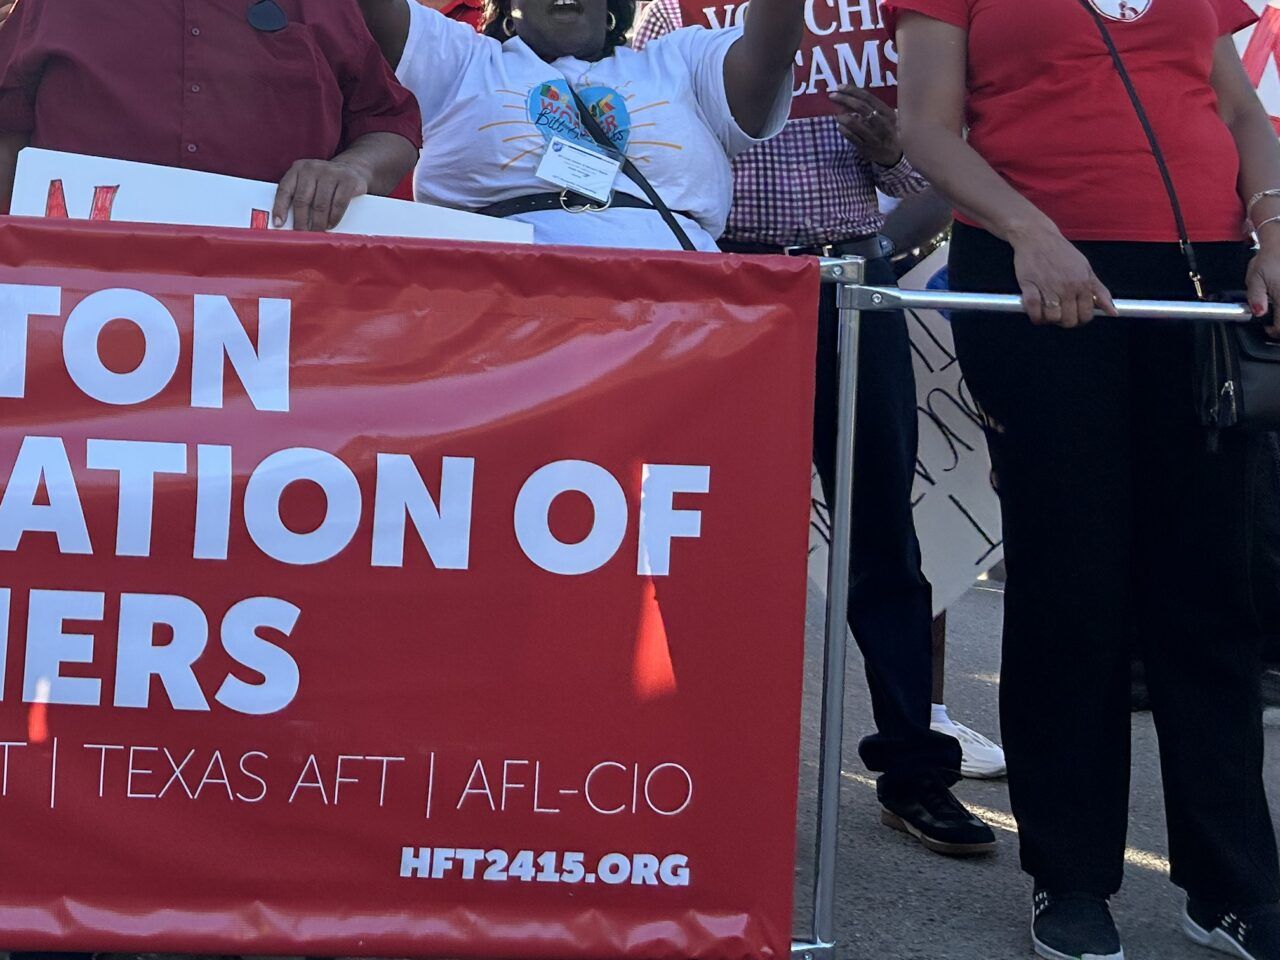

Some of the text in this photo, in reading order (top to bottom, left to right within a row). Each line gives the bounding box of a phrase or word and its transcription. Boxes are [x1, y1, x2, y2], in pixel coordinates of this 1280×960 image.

[513, 458, 711, 577] OF
[84, 744, 267, 802] TEXAS
[289, 754, 405, 807] AFT
[456, 758, 694, 816] AFL-CIO
[400, 846, 691, 887] HFT2415.ORG
